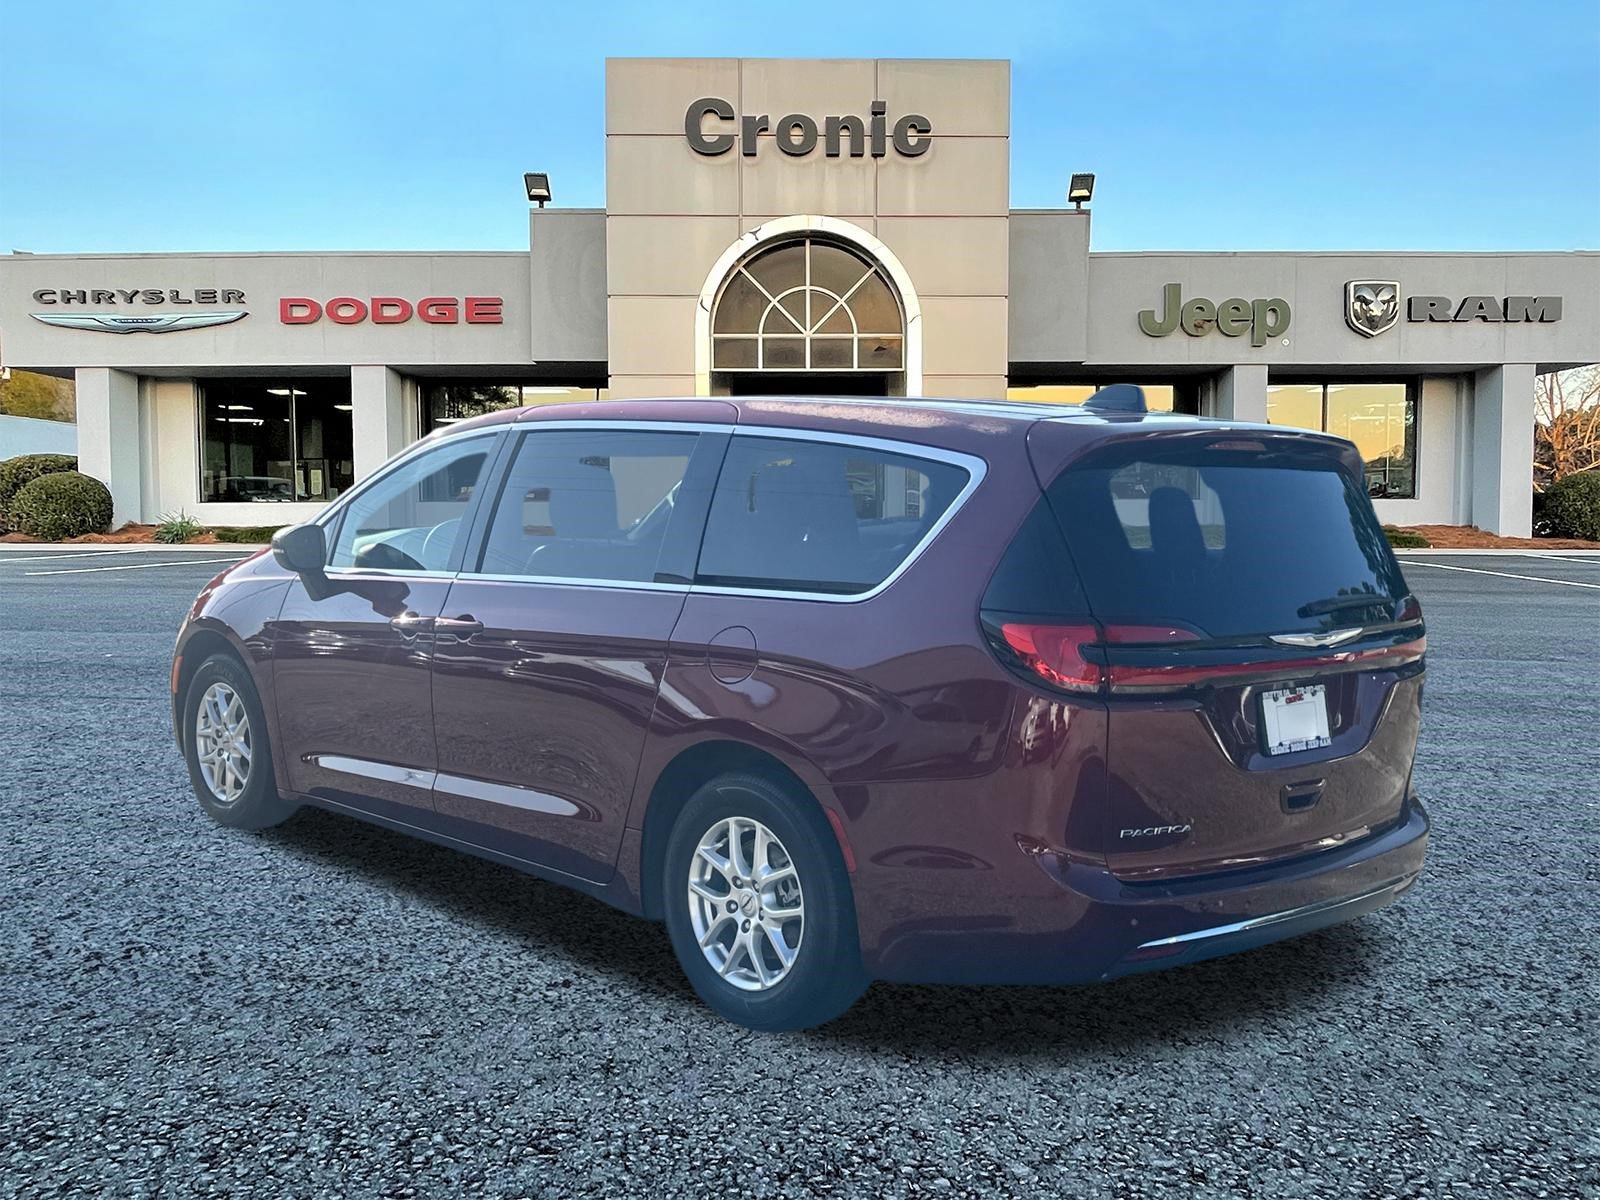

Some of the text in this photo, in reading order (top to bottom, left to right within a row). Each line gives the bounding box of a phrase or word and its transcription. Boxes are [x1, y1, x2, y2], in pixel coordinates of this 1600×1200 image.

[684, 97, 932, 158] Cronic
[32, 289, 246, 305] CHRYSLER
[1407, 296, 1563, 322] RAM
[279, 297, 504, 325] DODGE
[1138, 283, 1291, 347] Jeep
[1119, 824, 1192, 839] PACIFICA
